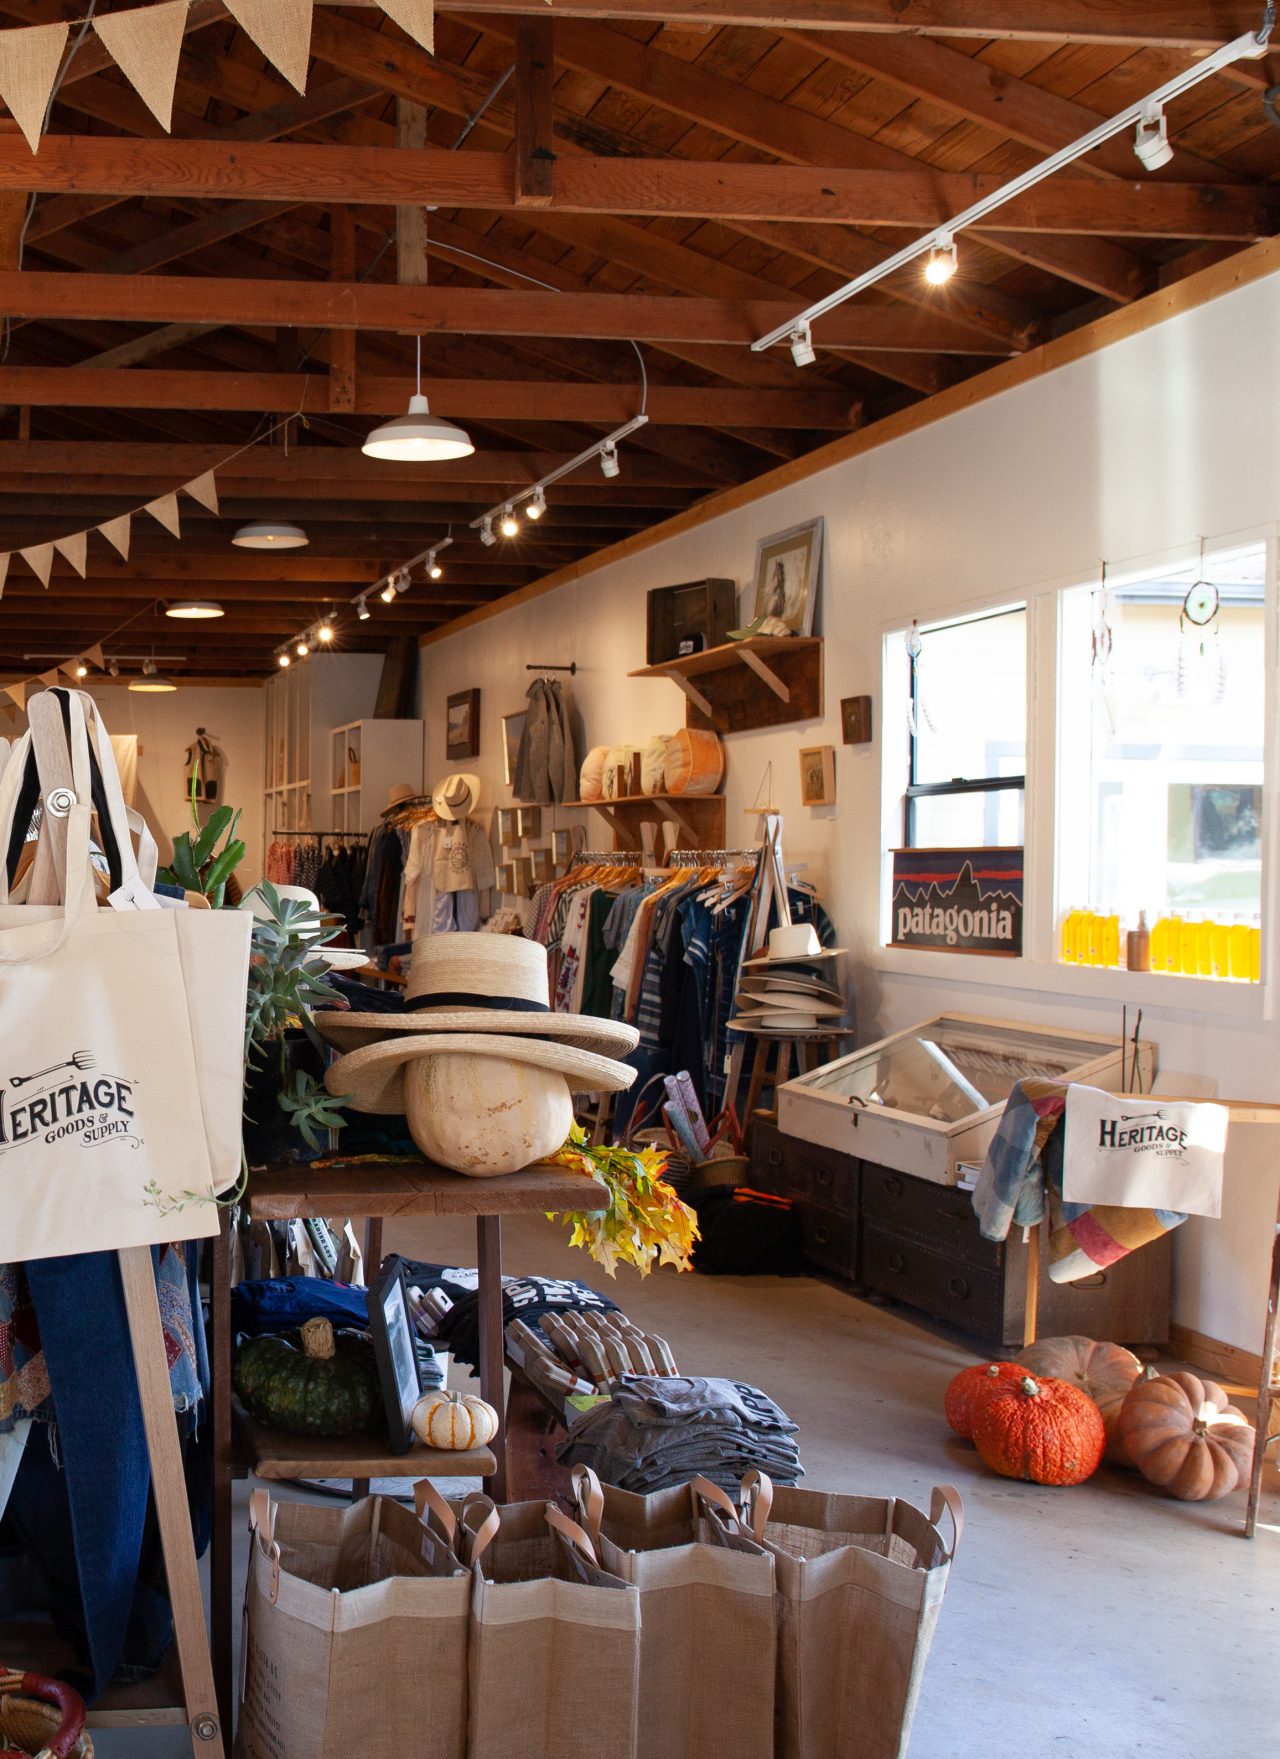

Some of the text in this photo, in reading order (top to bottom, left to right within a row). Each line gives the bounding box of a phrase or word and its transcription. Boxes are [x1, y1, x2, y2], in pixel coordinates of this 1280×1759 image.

[897, 902, 1013, 945] patagonia
[45, 1113, 108, 1144] GOODS &
[82, 1120, 130, 1143] SUPPLY
[1099, 1119, 1188, 1150] HERITAGE
[1134, 1142, 1163, 1152] GOODS
[1155, 1149, 1183, 1157] SUPPLY
[312, 1219, 332, 1258] RADISE LOT
